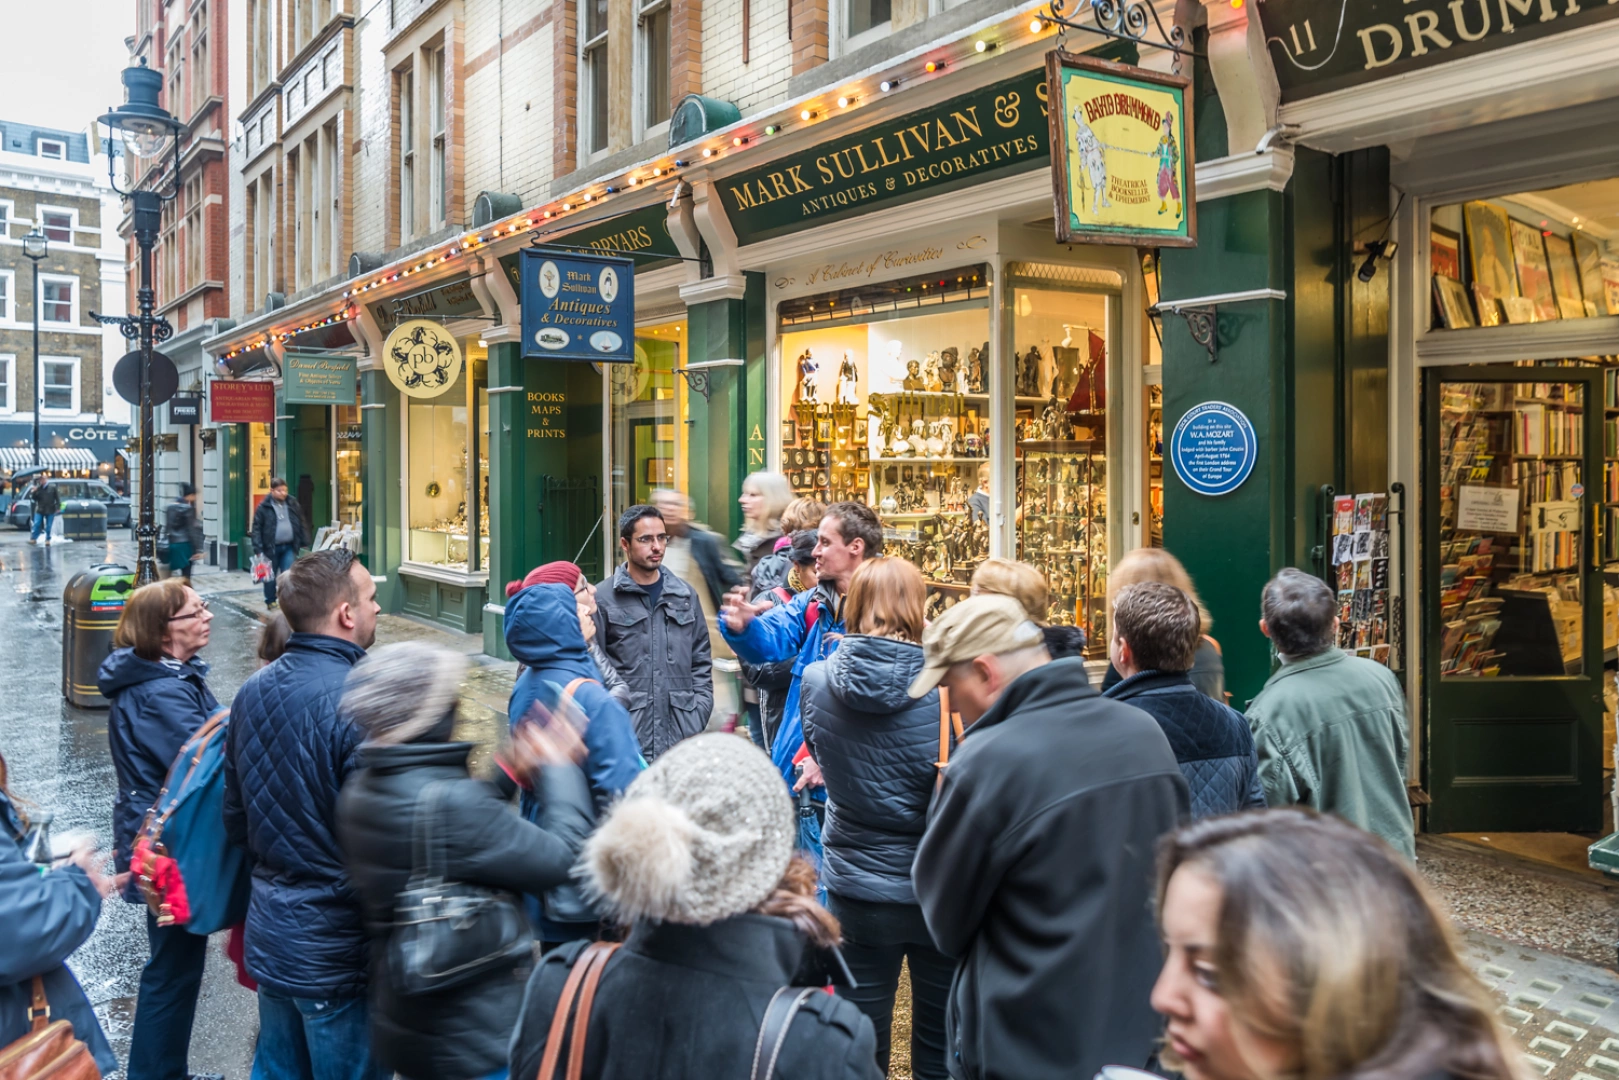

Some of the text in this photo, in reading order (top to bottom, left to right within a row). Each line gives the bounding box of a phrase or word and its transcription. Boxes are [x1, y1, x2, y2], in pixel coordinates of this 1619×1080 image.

[1289, 19, 1318, 56] 11
[1084, 92, 1161, 131] DAVID DRUMMOND
[730, 165, 814, 212] MARK
[816, 105, 984, 185] SULLIVAN
[994, 91, 1021, 128] &
[801, 135, 1039, 216] ANTIQUES & DECORATIVES
[1111, 175, 1148, 189] THEATRICAL
[1111, 184, 1149, 197] BOOKSELLER
[1108, 191, 1151, 205] & EPHEMERIST
[805, 247, 944, 286] A Cabinet of Curiosities
[566, 271, 592, 282] Mark
[562, 282, 597, 294] Sullivan
[548, 297, 612, 316] Antiques
[541, 313, 618, 328] & Decoratives
[290, 358, 318, 369] Daniel
[412, 346, 434, 369] pb
[527, 392, 565, 402] BOOKS
[531, 405, 562, 415] MAPS
[542, 417, 550, 426] &
[1222, 406, 1248, 429] ASSOCIATION
[68, 427, 118, 441] CÔTE
[527, 428, 566, 438] PRINTS
[1206, 430, 1234, 438] MOZART
